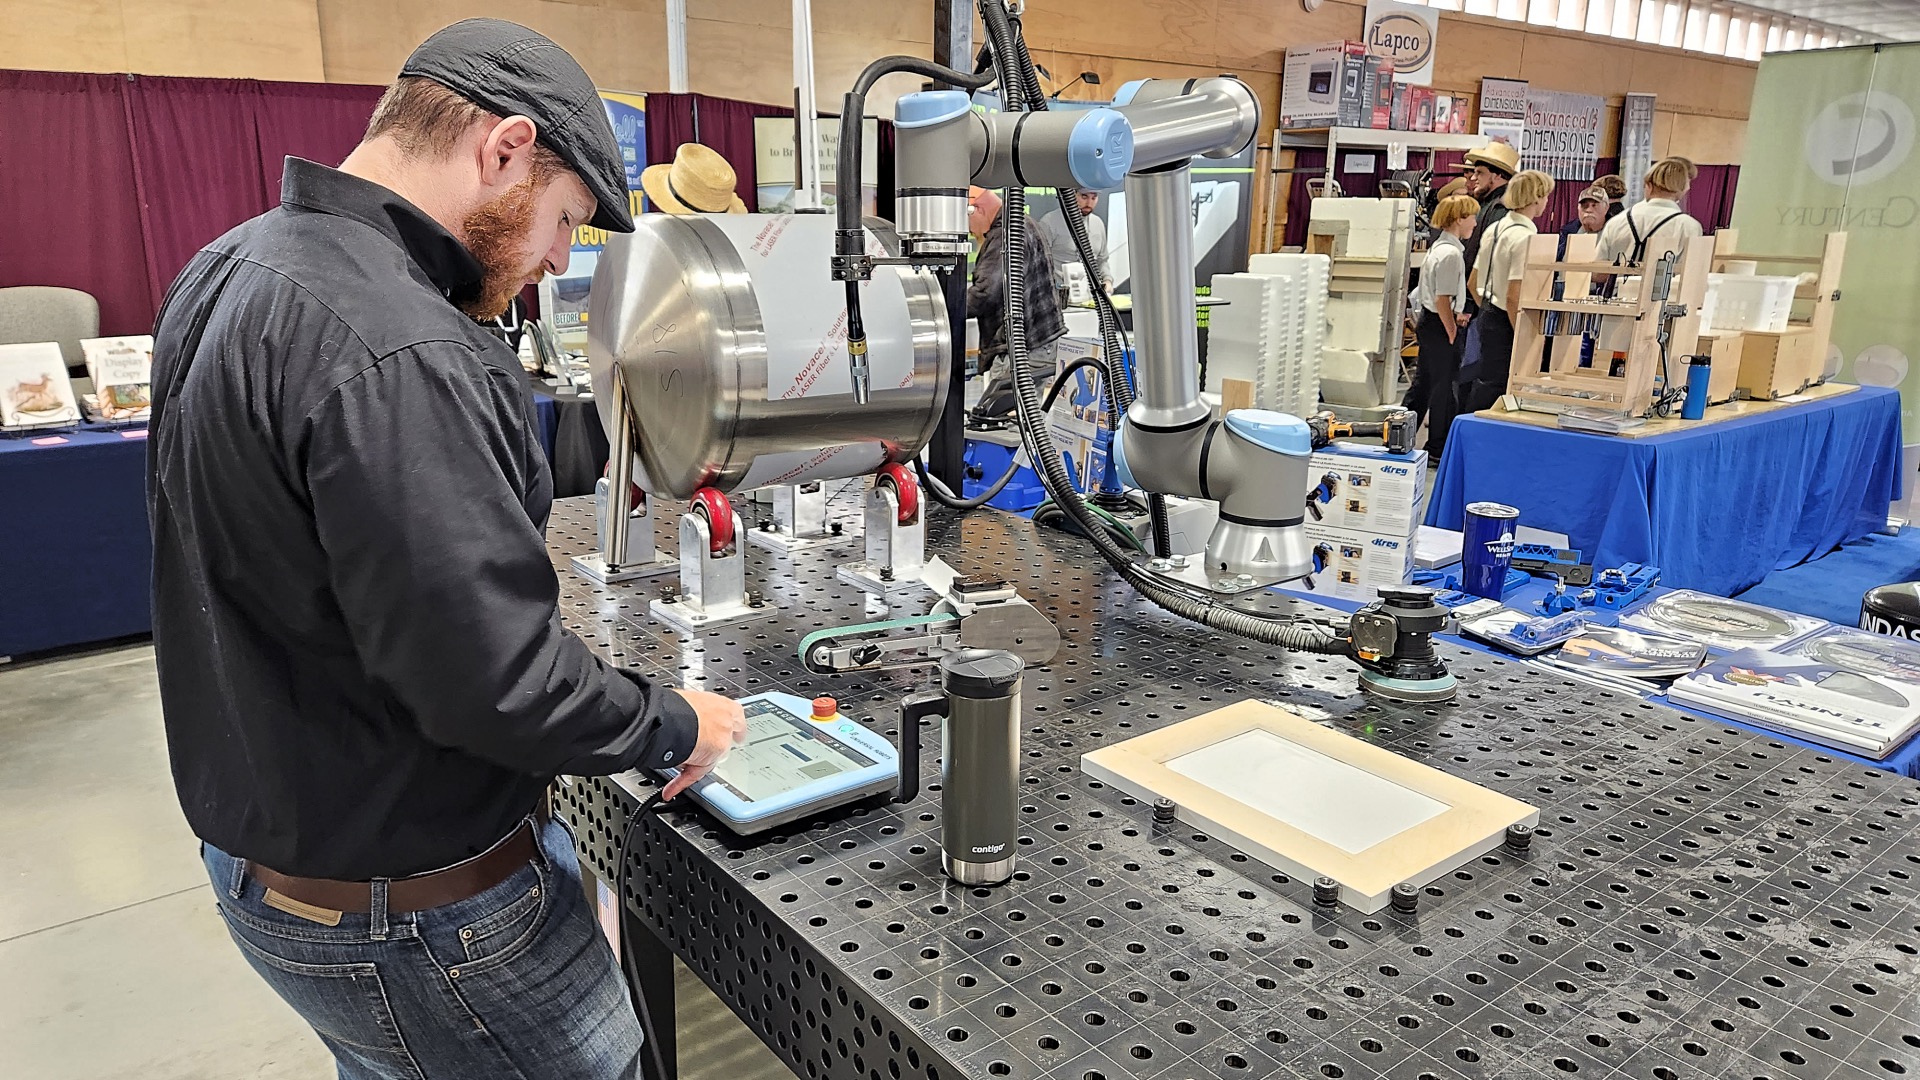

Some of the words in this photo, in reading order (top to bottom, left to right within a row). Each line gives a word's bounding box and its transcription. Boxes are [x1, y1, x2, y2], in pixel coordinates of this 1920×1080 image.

[1374, 25, 1420, 55] Lapco
[1484, 96, 1525, 111] DIMENSIONS
[1521, 129, 1596, 155] DIMENSIONS
[555, 312, 579, 325] BEFORE
[104, 355, 144, 369] Display
[112, 369, 141, 380] Copy
[781, 385, 797, 400] The
[795, 341, 826, 385] Novacel
[797, 373, 818, 399] LASER
[815, 355, 831, 376] Fiber
[1384, 465, 1408, 476] Kreg
[1375, 538, 1399, 549] Kreg
[1753, 691, 1886, 730] TENRYU
[971, 842, 1006, 854] contigo
